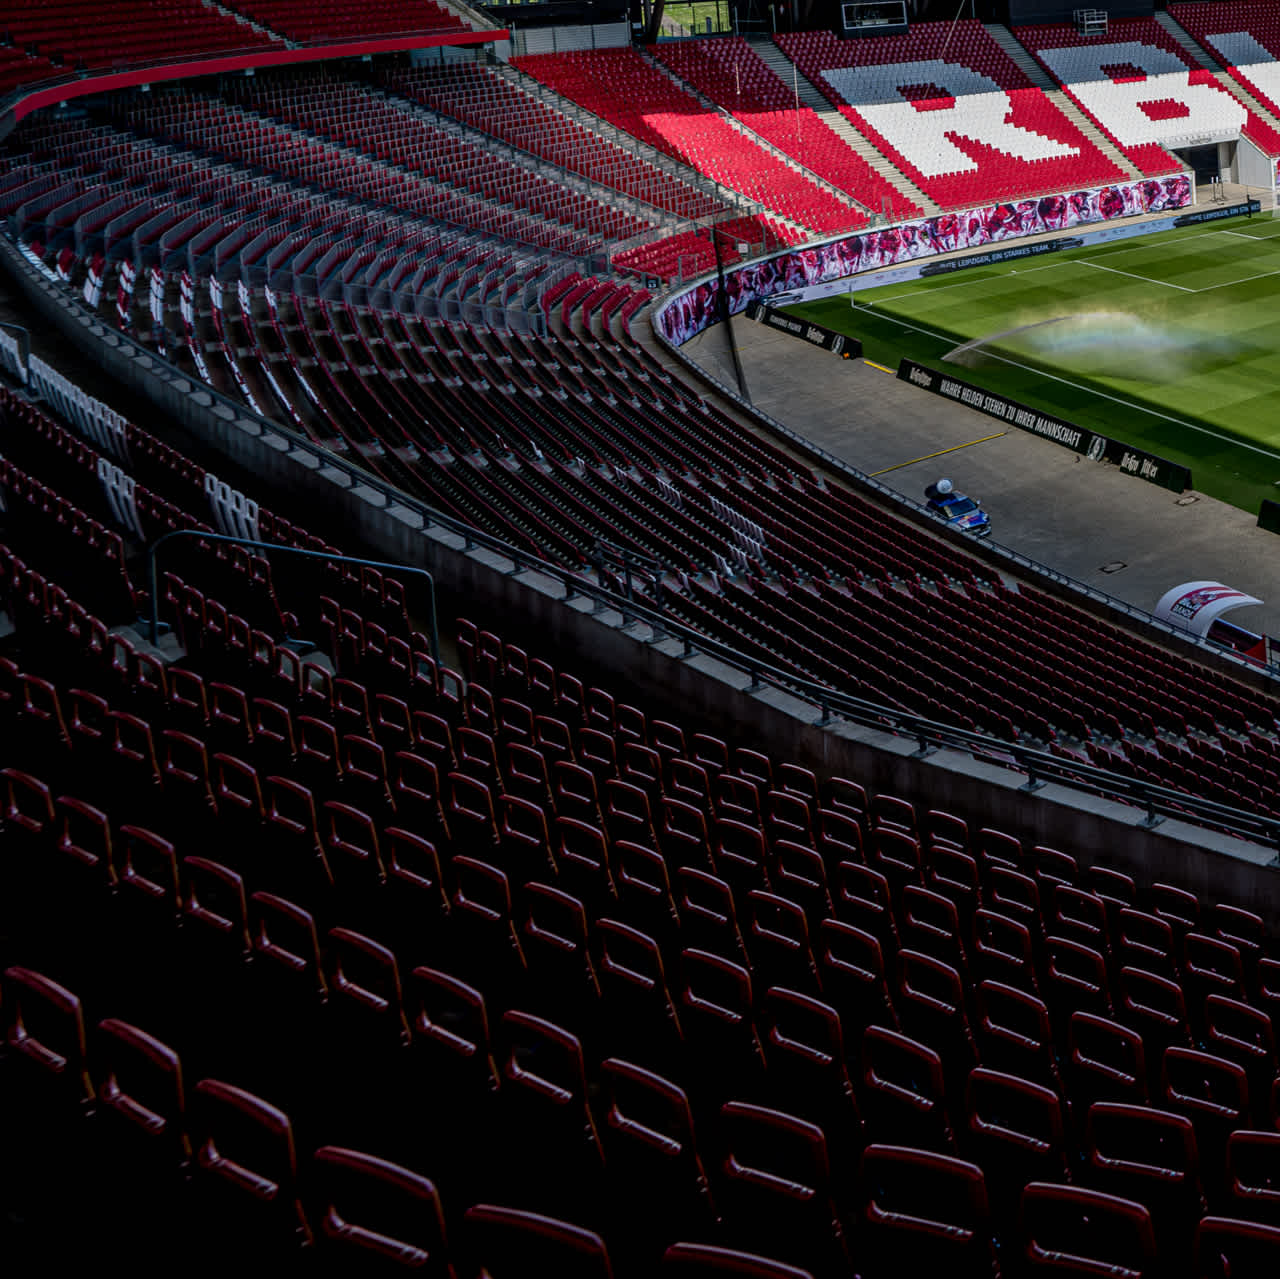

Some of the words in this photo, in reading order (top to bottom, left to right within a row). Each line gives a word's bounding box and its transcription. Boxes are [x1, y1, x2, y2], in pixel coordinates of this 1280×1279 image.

[983, 396, 1006, 416] STEHEN
[1006, 405, 1016, 420] ZU
[1015, 408, 1036, 427] IHRER
[1036, 417, 1083, 448] MANNSCHAFT
